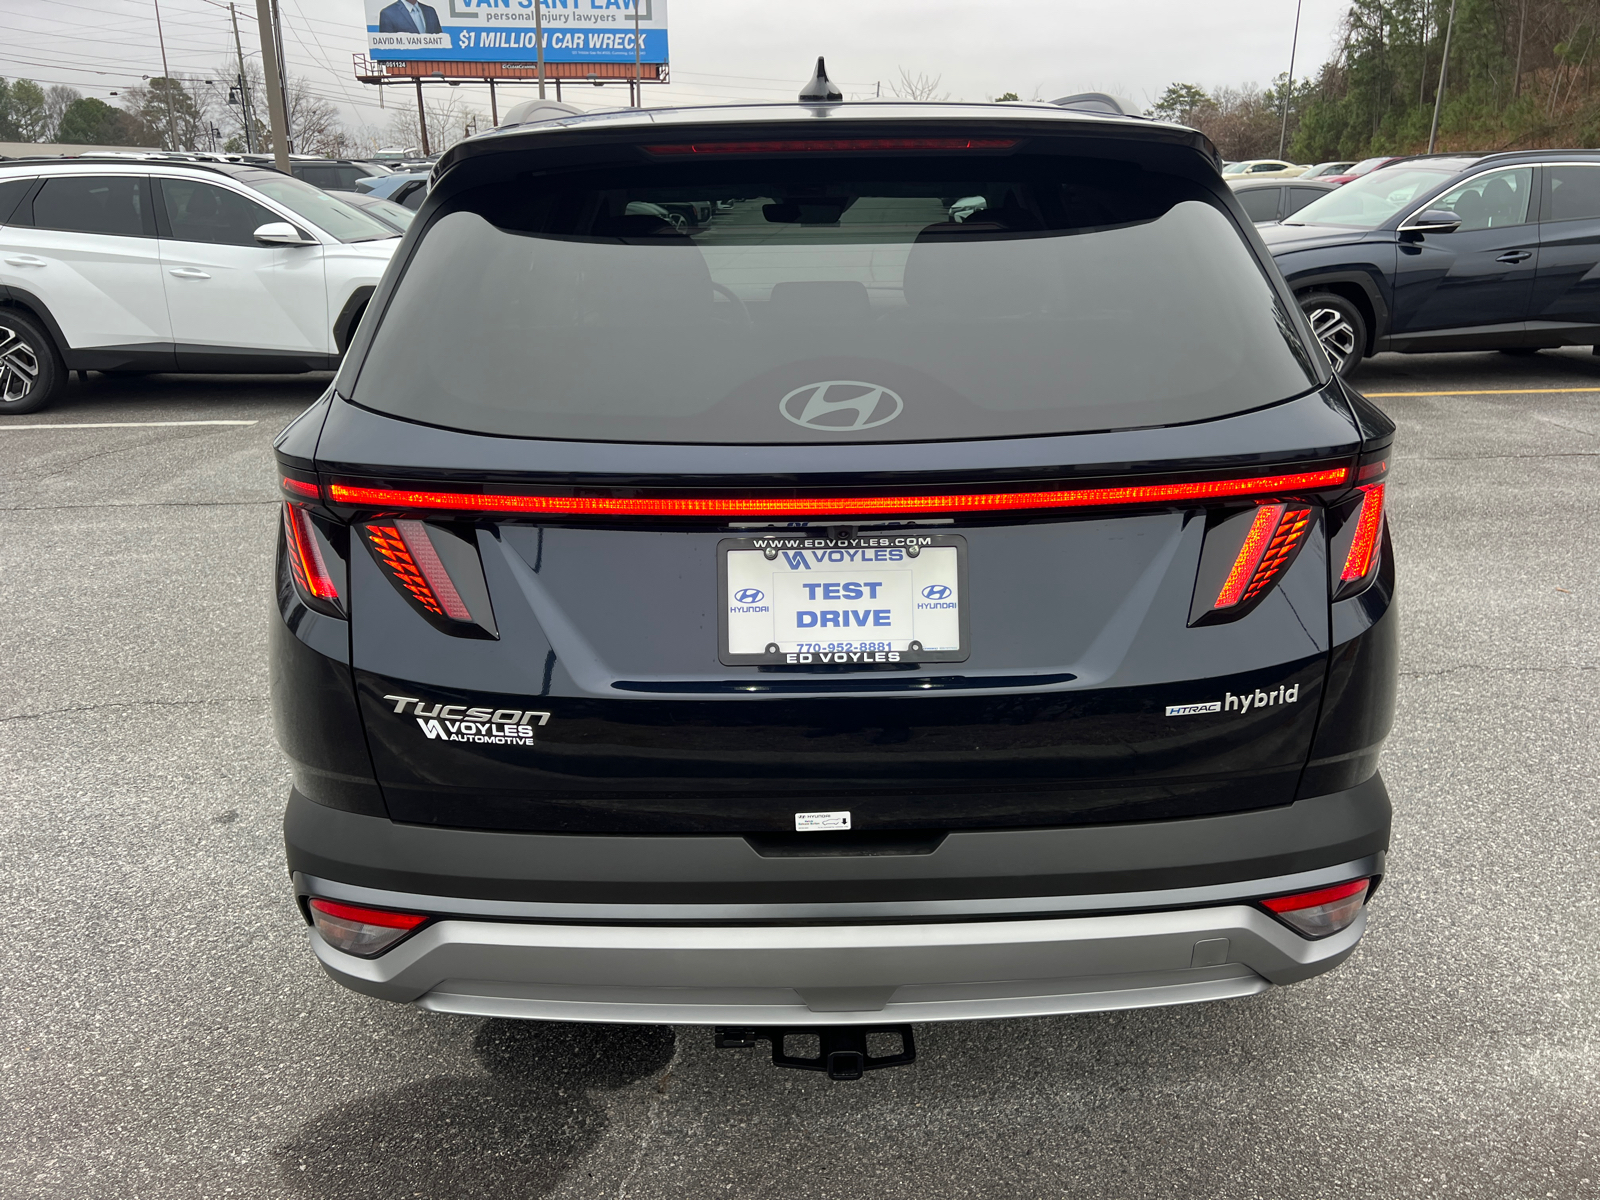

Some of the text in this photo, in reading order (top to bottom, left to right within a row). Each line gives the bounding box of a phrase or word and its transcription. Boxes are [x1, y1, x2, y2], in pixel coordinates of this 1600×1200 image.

[486, 10, 617, 24] personal njury lawyers
[372, 37, 443, 46] DAVID M. VAN SANT
[459, 29, 647, 50] $1 MILLION CAR WRECK
[753, 537, 932, 548] WWW.EDVOYLES.COM
[811, 549, 904, 563] VOYLES
[802, 581, 883, 601] TEST
[730, 606, 770, 614] HYUNDAI
[917, 602, 957, 610] HYUNDAI
[796, 608, 892, 629] DRIVE
[796, 641, 893, 653] 770-952-8881
[786, 652, 901, 664] ED VOYLES
[1224, 683, 1300, 715] hybrid
[383, 694, 551, 726] TUCSON
[1169, 703, 1218, 715] HTRAC
[445, 720, 534, 738] VOYLES
[449, 734, 535, 746] AUTOMOTIVE
